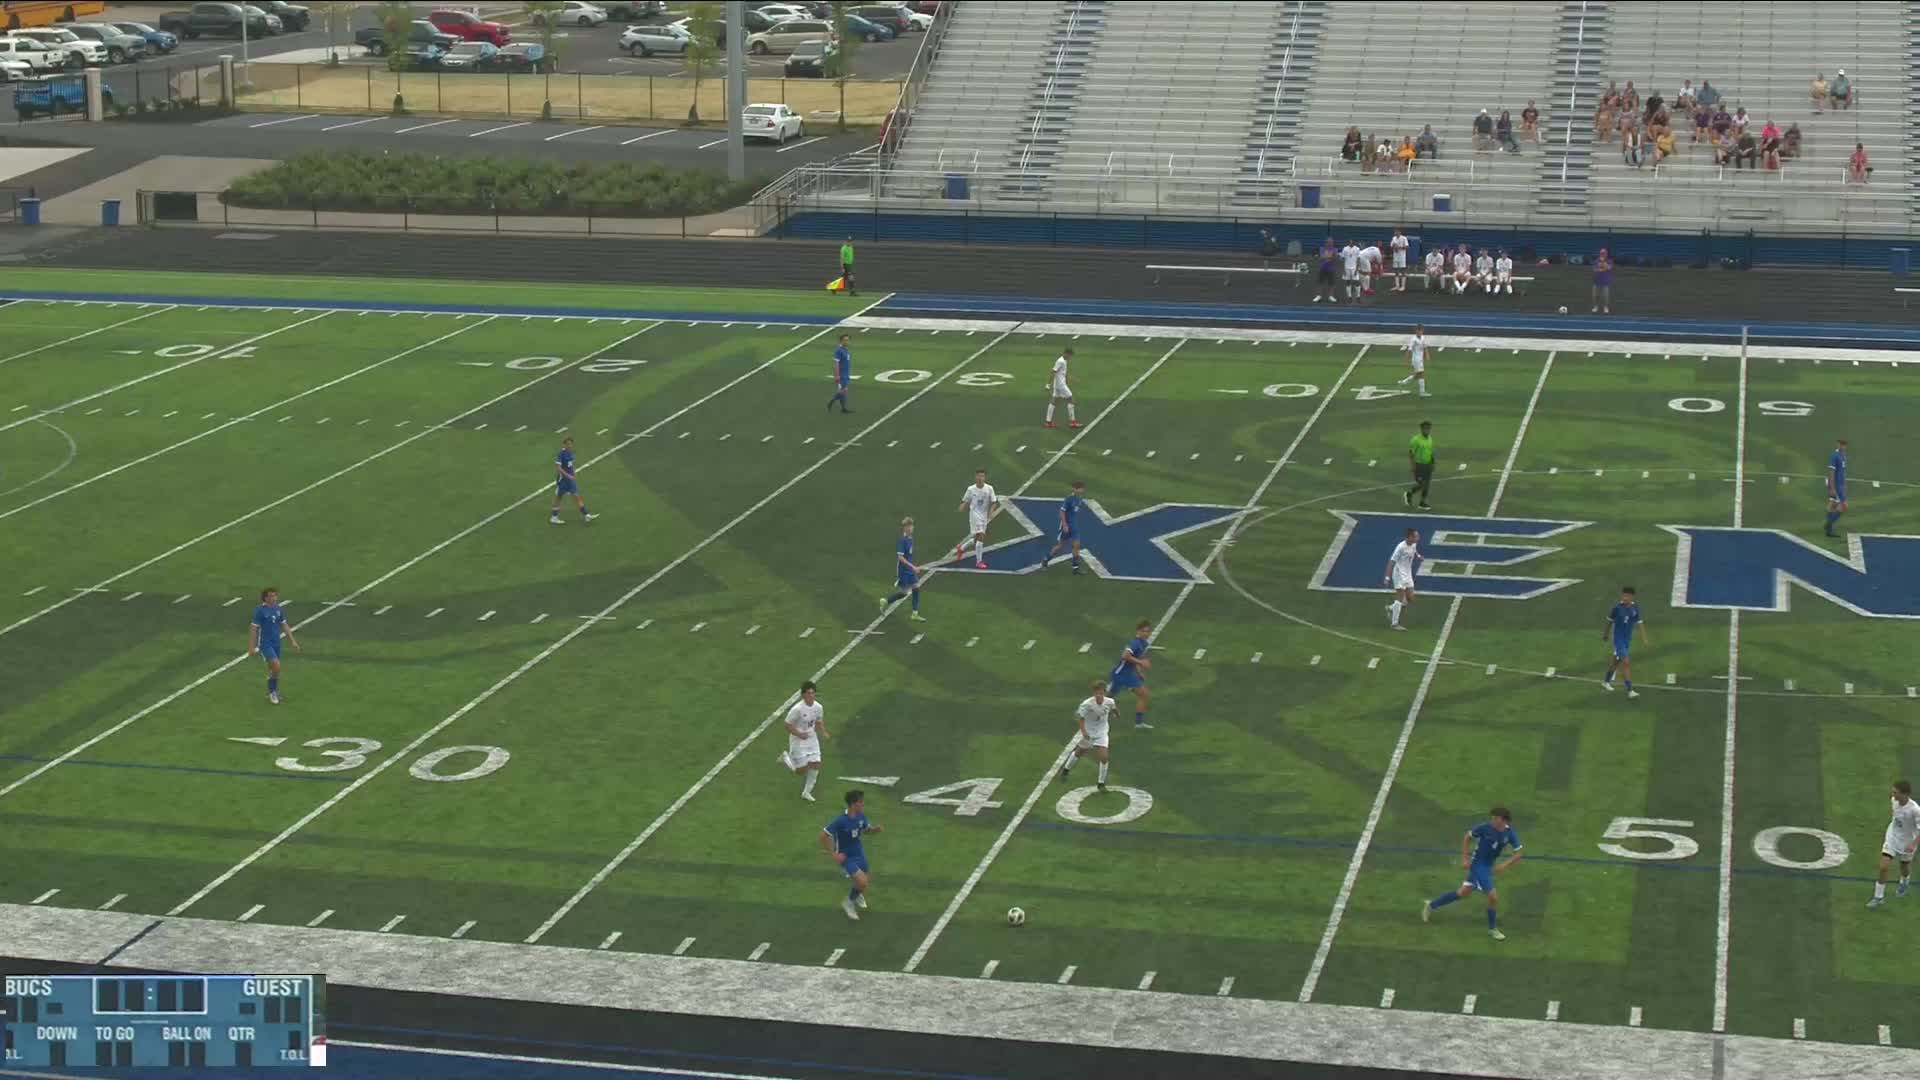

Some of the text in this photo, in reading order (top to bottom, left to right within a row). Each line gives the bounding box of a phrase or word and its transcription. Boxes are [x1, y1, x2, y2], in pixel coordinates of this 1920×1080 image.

[275, 737, 510, 782] 30
[902, 778, 1153, 824] 40
[1597, 816, 1850, 870] 50
